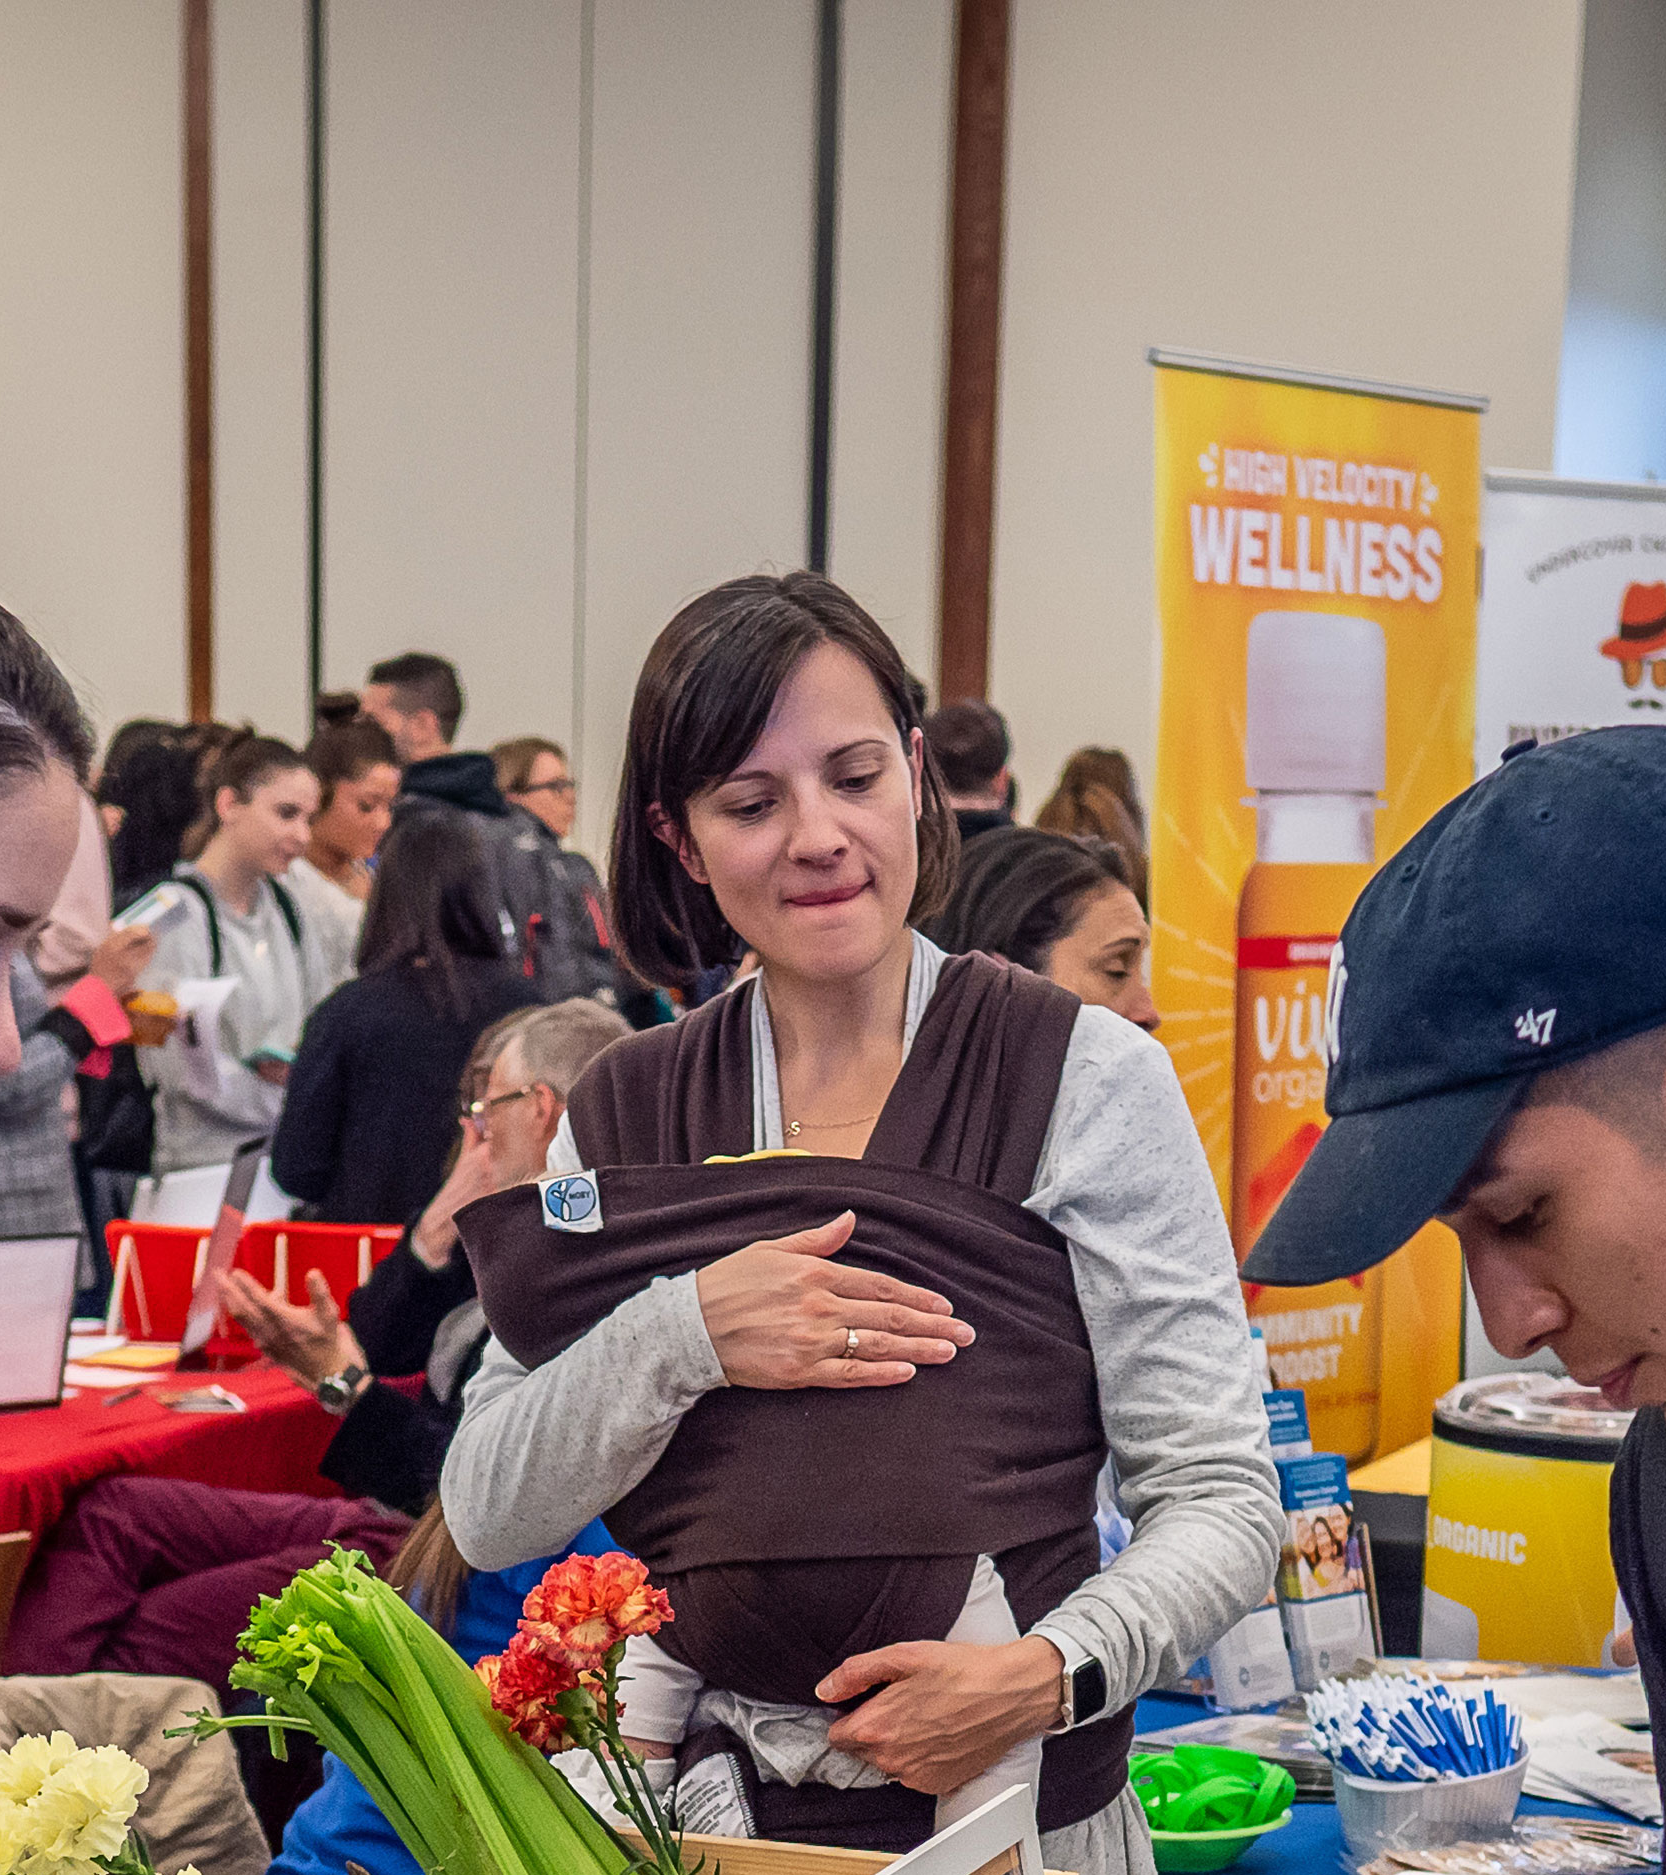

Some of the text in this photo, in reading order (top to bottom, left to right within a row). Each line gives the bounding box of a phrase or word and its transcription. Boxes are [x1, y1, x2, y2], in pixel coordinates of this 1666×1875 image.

[1223, 449, 1416, 511] HIGH VELOCITY
[1190, 504, 1443, 603] WELLNESS
[1433, 1514, 1528, 1567] ORGANIC
